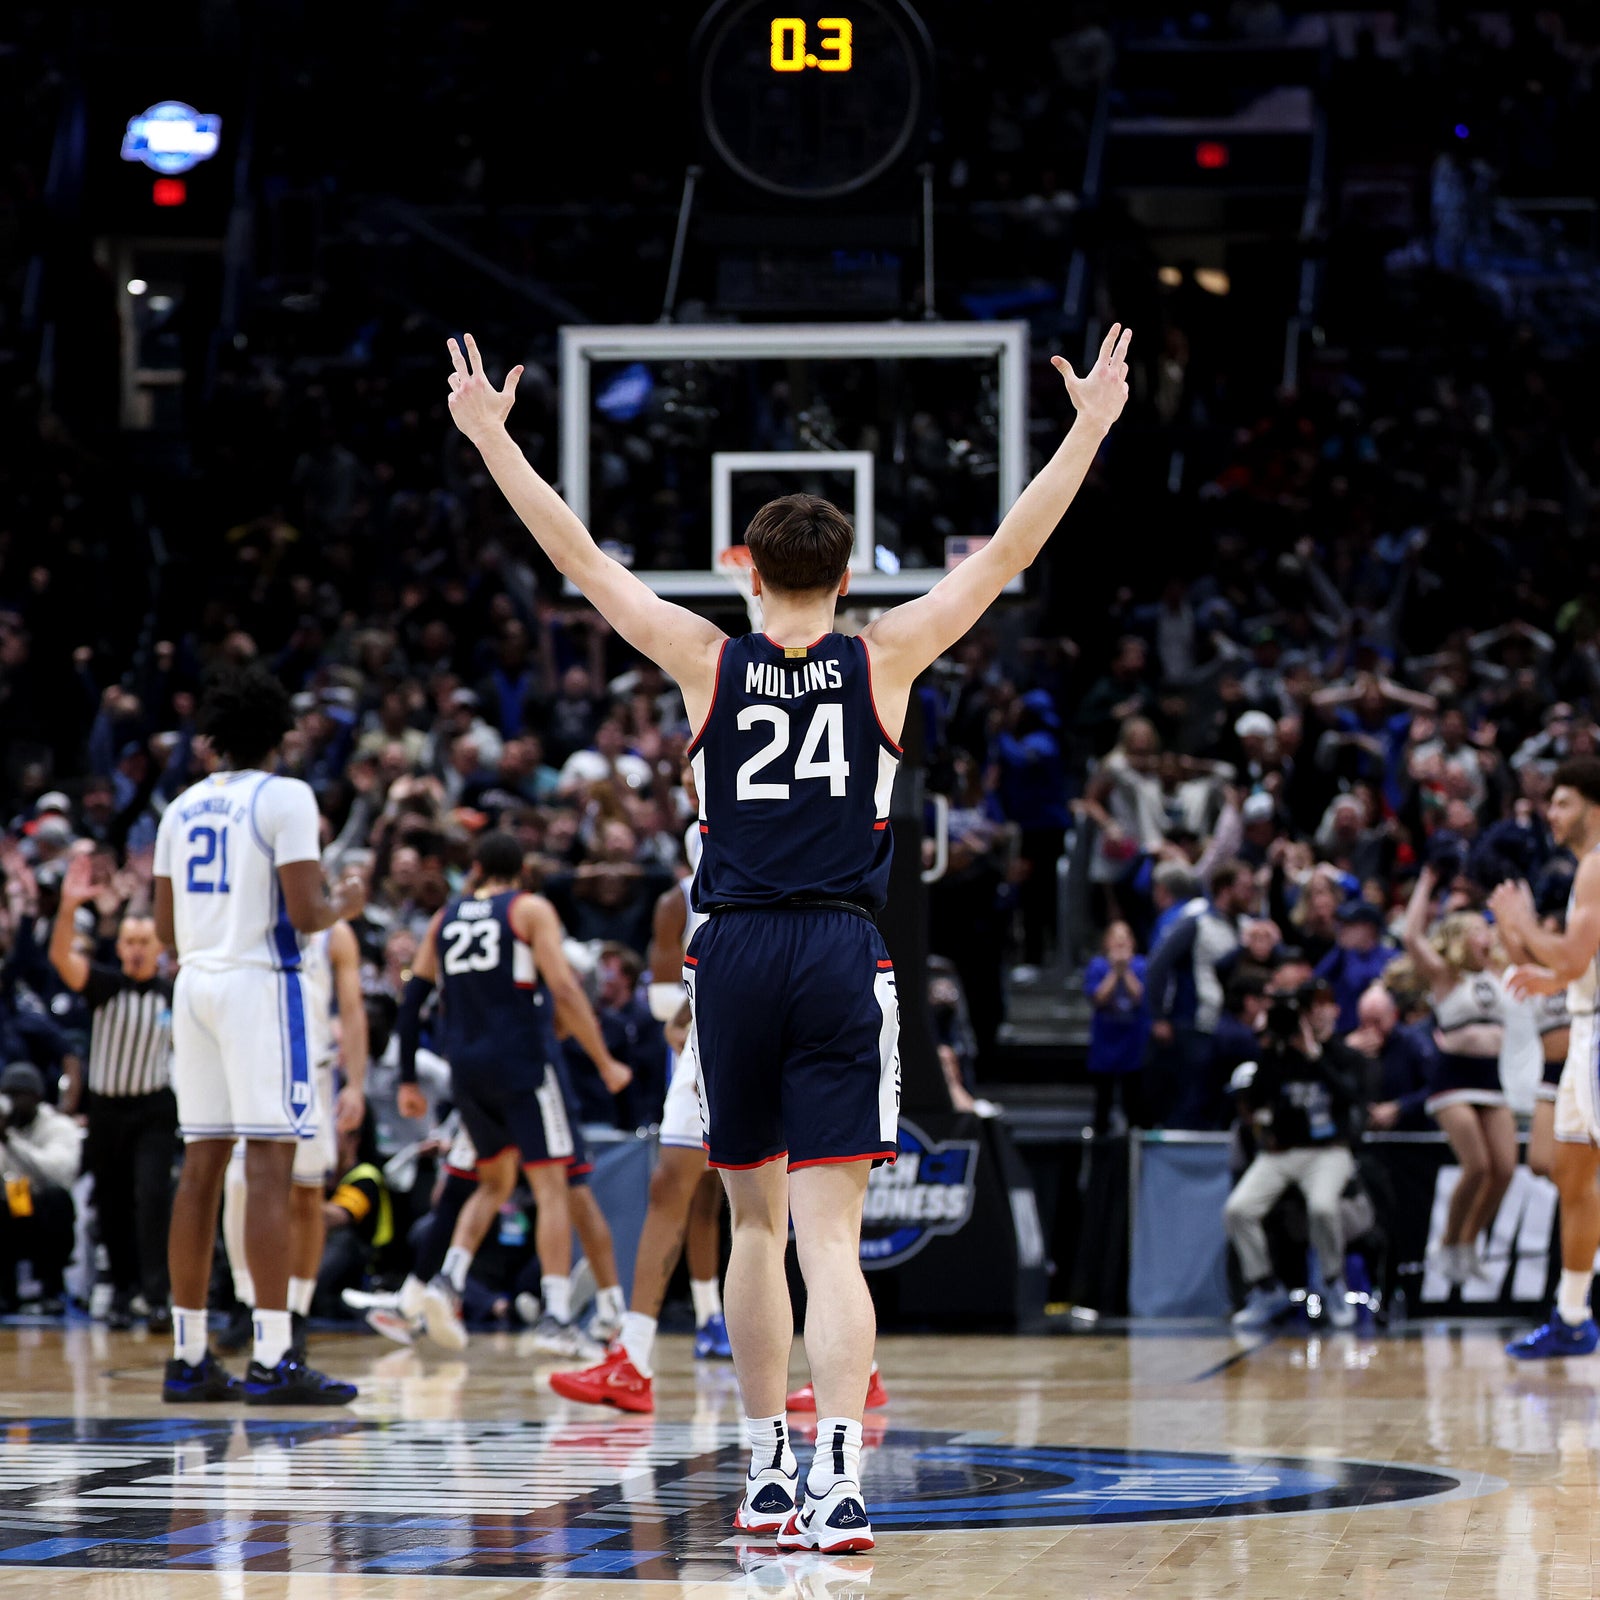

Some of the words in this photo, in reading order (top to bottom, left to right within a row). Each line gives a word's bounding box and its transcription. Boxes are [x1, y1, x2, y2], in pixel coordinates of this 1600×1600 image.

[770, 17, 852, 72] 0.3
[745, 659, 843, 699] MULLINS
[736, 703, 850, 801] 24
[187, 826, 230, 893] 21
[442, 918, 501, 976] 23
